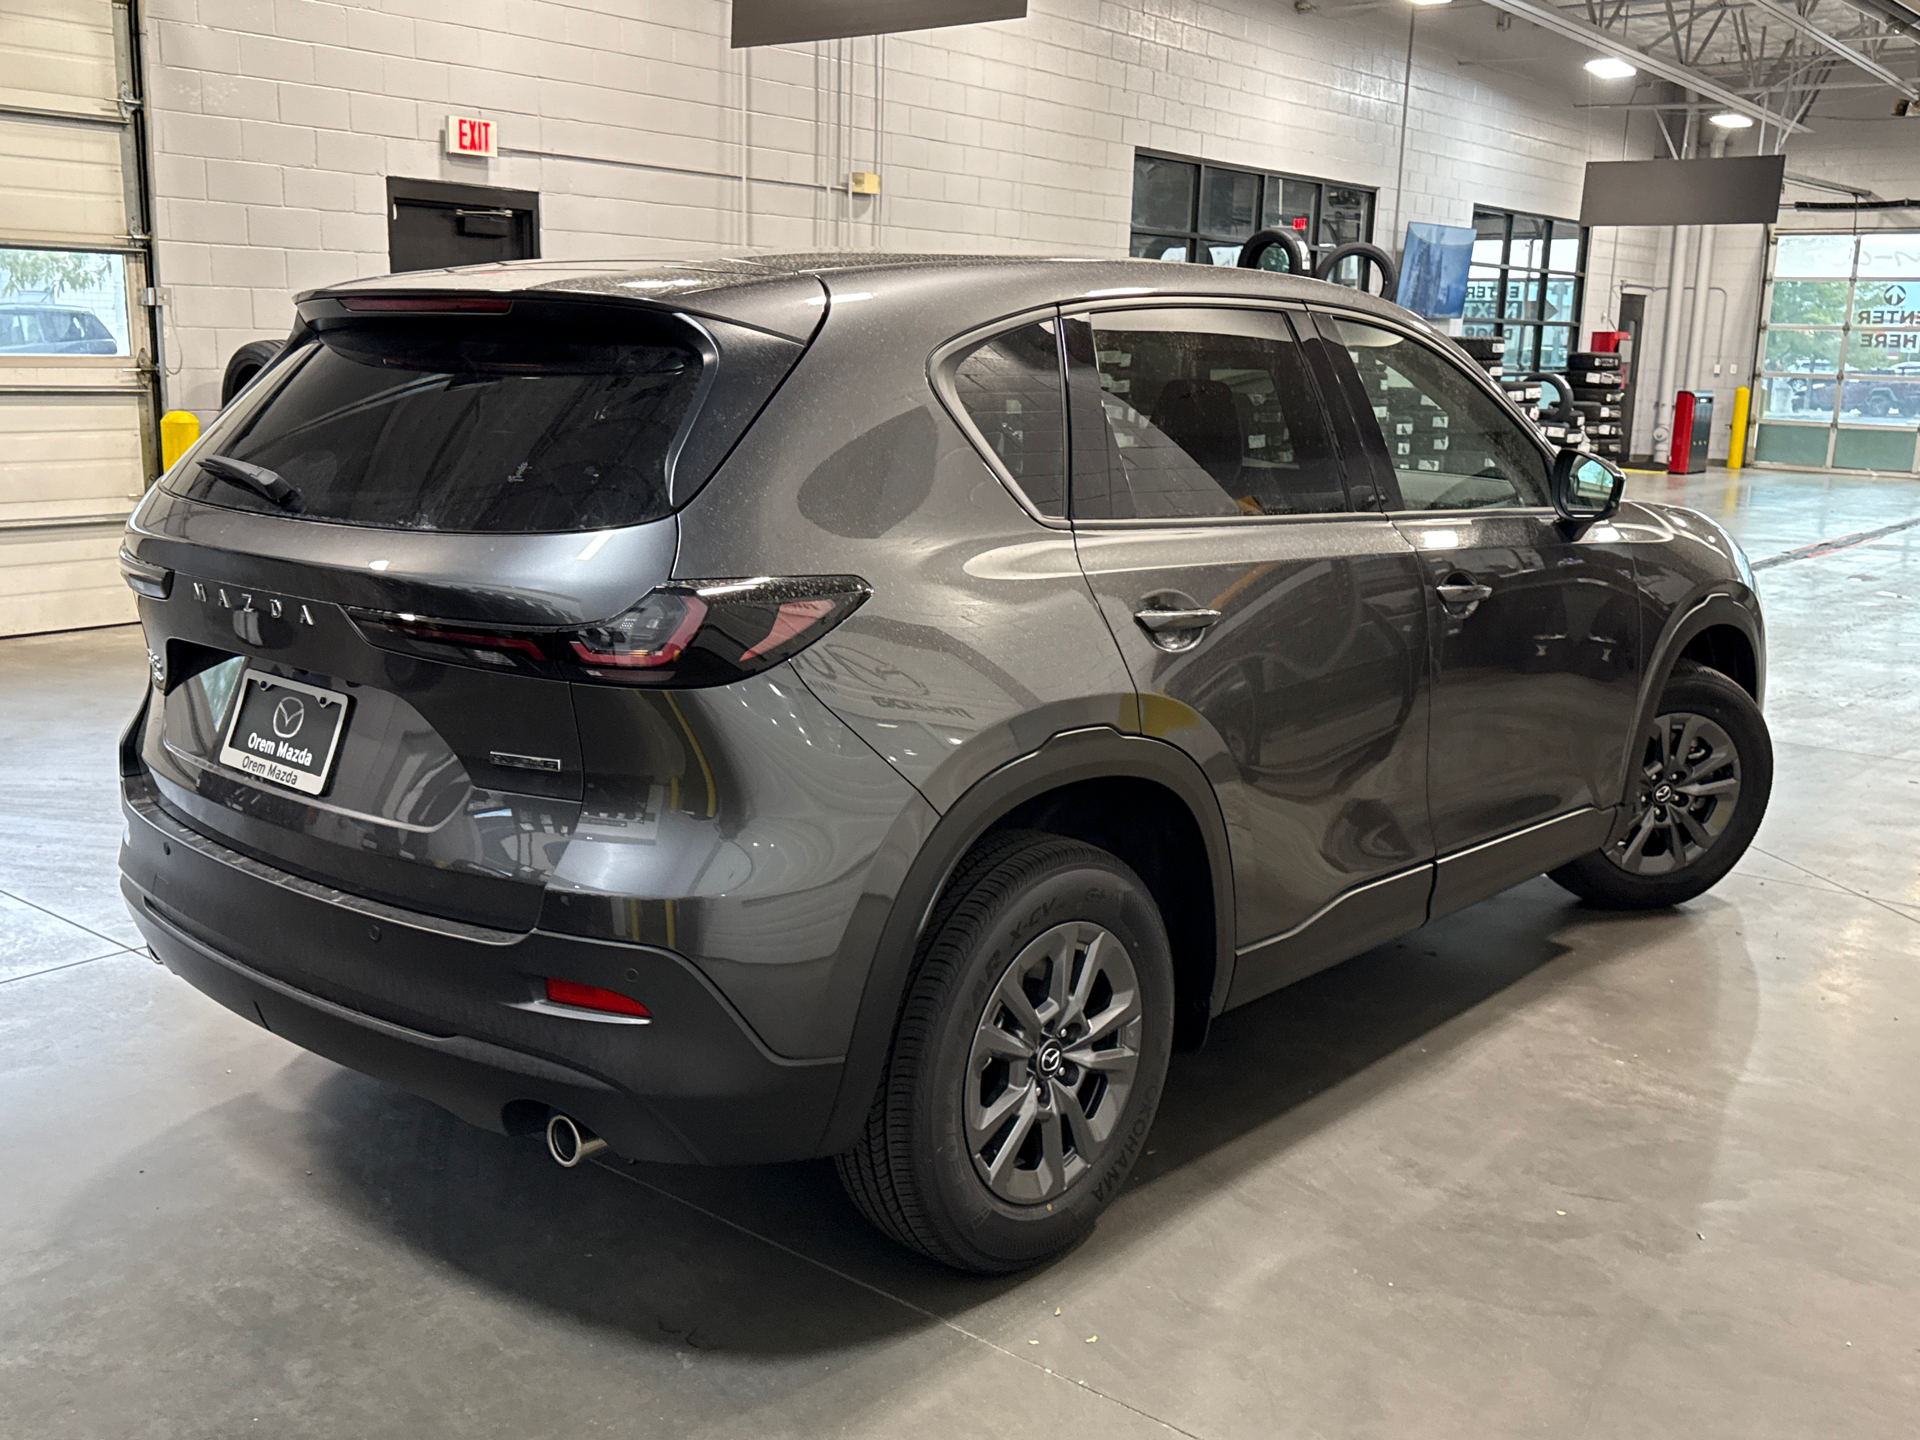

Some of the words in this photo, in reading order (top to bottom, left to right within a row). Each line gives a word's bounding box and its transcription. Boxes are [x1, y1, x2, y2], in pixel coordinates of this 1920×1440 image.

[458, 118, 491, 153] EXIT
[193, 582, 314, 626] MAZDA
[247, 731, 277, 755] Orem
[277, 739, 313, 767] Mazda
[241, 754, 266, 777] Orem
[266, 763, 298, 786] Mazda
